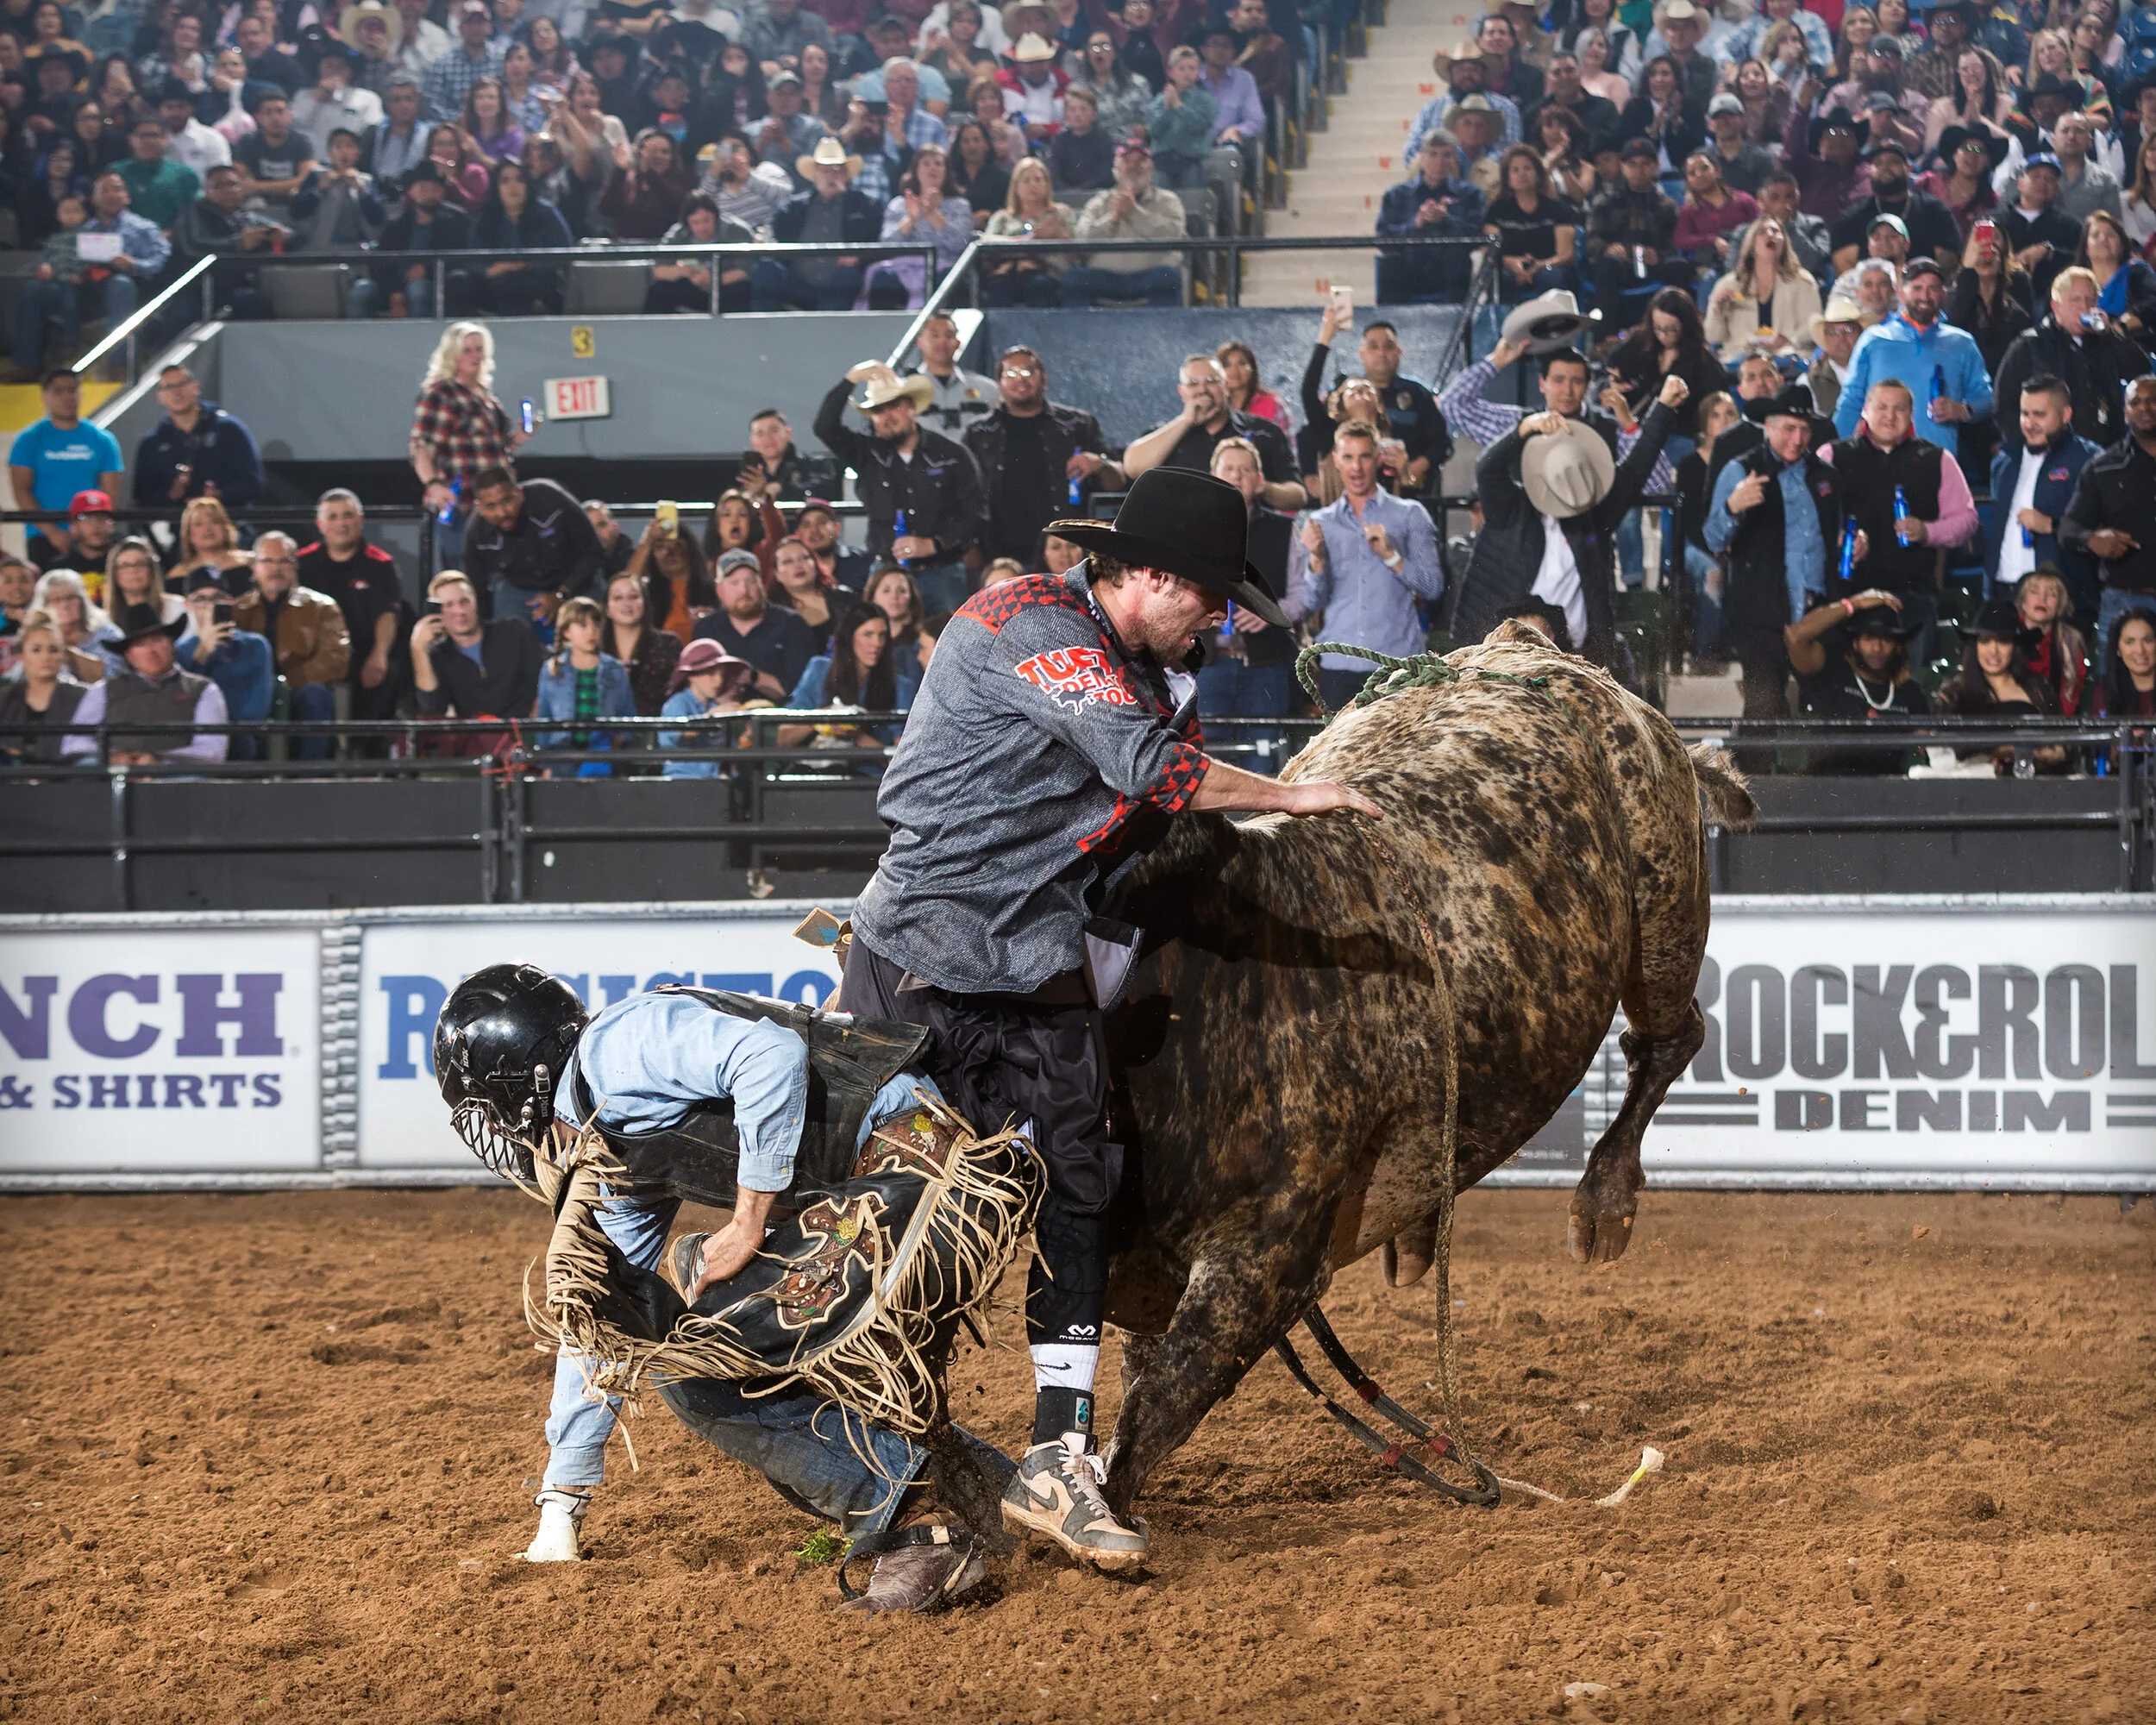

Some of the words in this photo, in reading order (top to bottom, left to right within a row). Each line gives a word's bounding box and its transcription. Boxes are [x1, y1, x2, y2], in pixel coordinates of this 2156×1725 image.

[573, 329, 591, 353] 3
[557, 380, 597, 414] EXIT
[0, 973, 284, 1061] NCH
[53, 1073, 282, 1109] SHIRTS
[1774, 1089, 2091, 1132] DENIM
